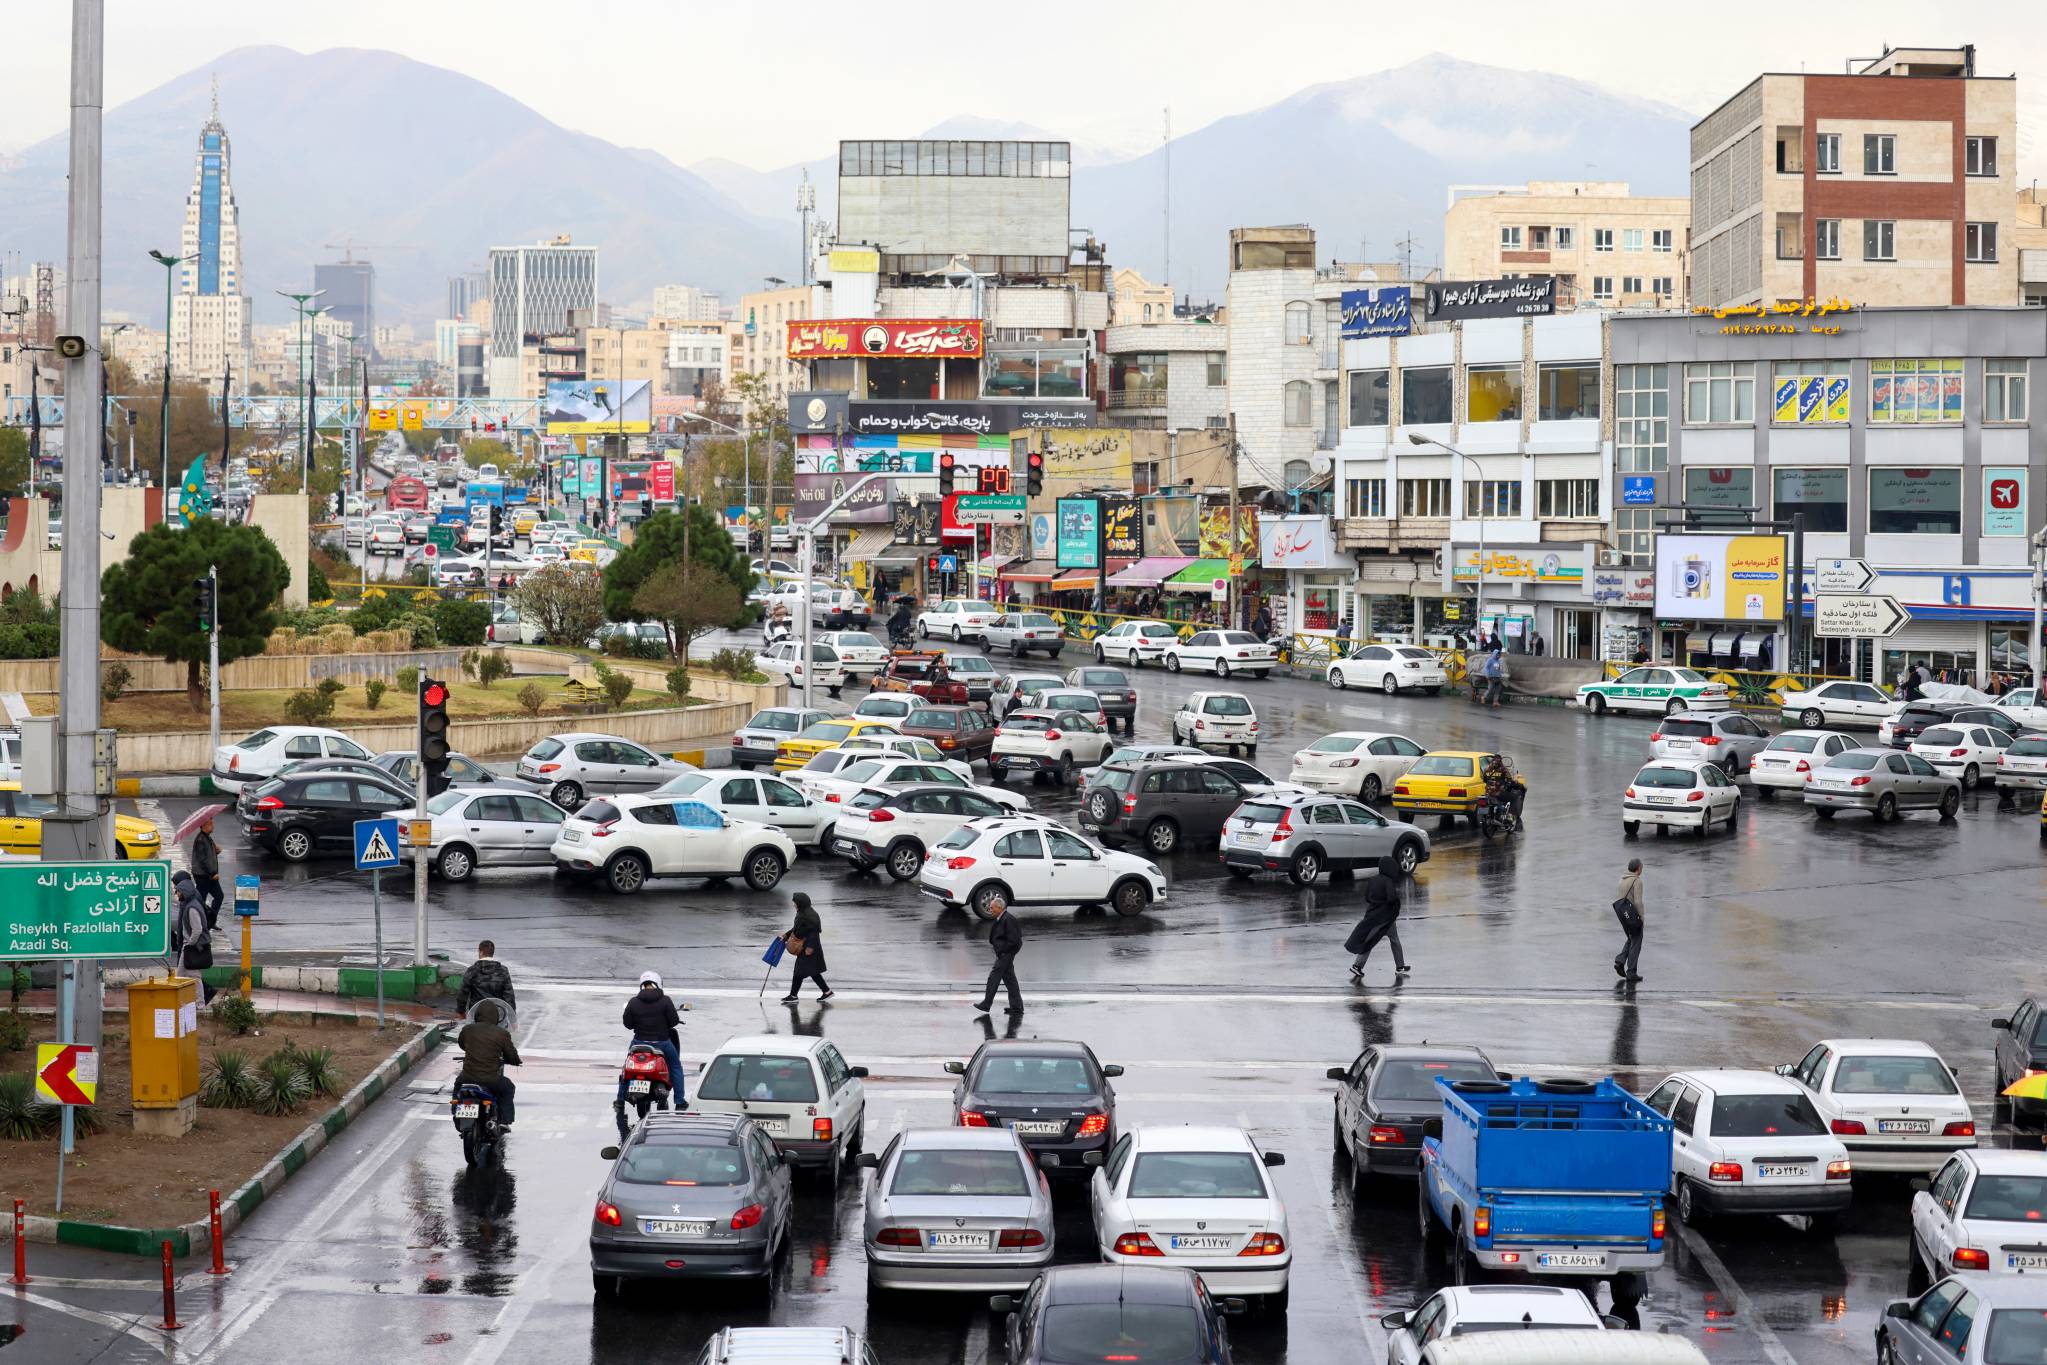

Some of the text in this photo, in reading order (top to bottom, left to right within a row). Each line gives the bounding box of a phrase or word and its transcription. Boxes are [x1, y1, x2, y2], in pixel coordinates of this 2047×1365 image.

[1458, 283, 1480, 305] آوای
[1478, 285, 1509, 303] موسیقی
[1511, 280, 1551, 300] آموزشگاه
[1391, 294, 1407, 322] دفتر
[1714, 303, 1767, 318] رسمی
[1772, 295, 1816, 317] ترجمه
[1818, 296, 1851, 317] دفتر
[1777, 380, 1797, 403] رسمی
[1801, 378, 1824, 413] ترجمه
[859, 414, 890, 429] حمام
[899, 415, 930, 429] خواب
[1022, 411, 1049, 420] خودت
[890, 419, 898, 429] و
[800, 488, 826, 501] Niri Oil
[867, 485, 884, 502] روغن
[961, 512, 989, 520] ستارخان
[1766, 556, 1779, 568] گاز
[1842, 600, 1870, 609] ستارخان
[1822, 609, 1848, 618] صادقیه
[1848, 610, 1861, 619] اول
[37, 871, 140, 892] شیخ فضل اله
[89, 895, 140, 916] آزادی
[9, 922, 150, 937] Sheykh Fazlollah Exp
[9, 938, 73, 952] Azadi Sq.
